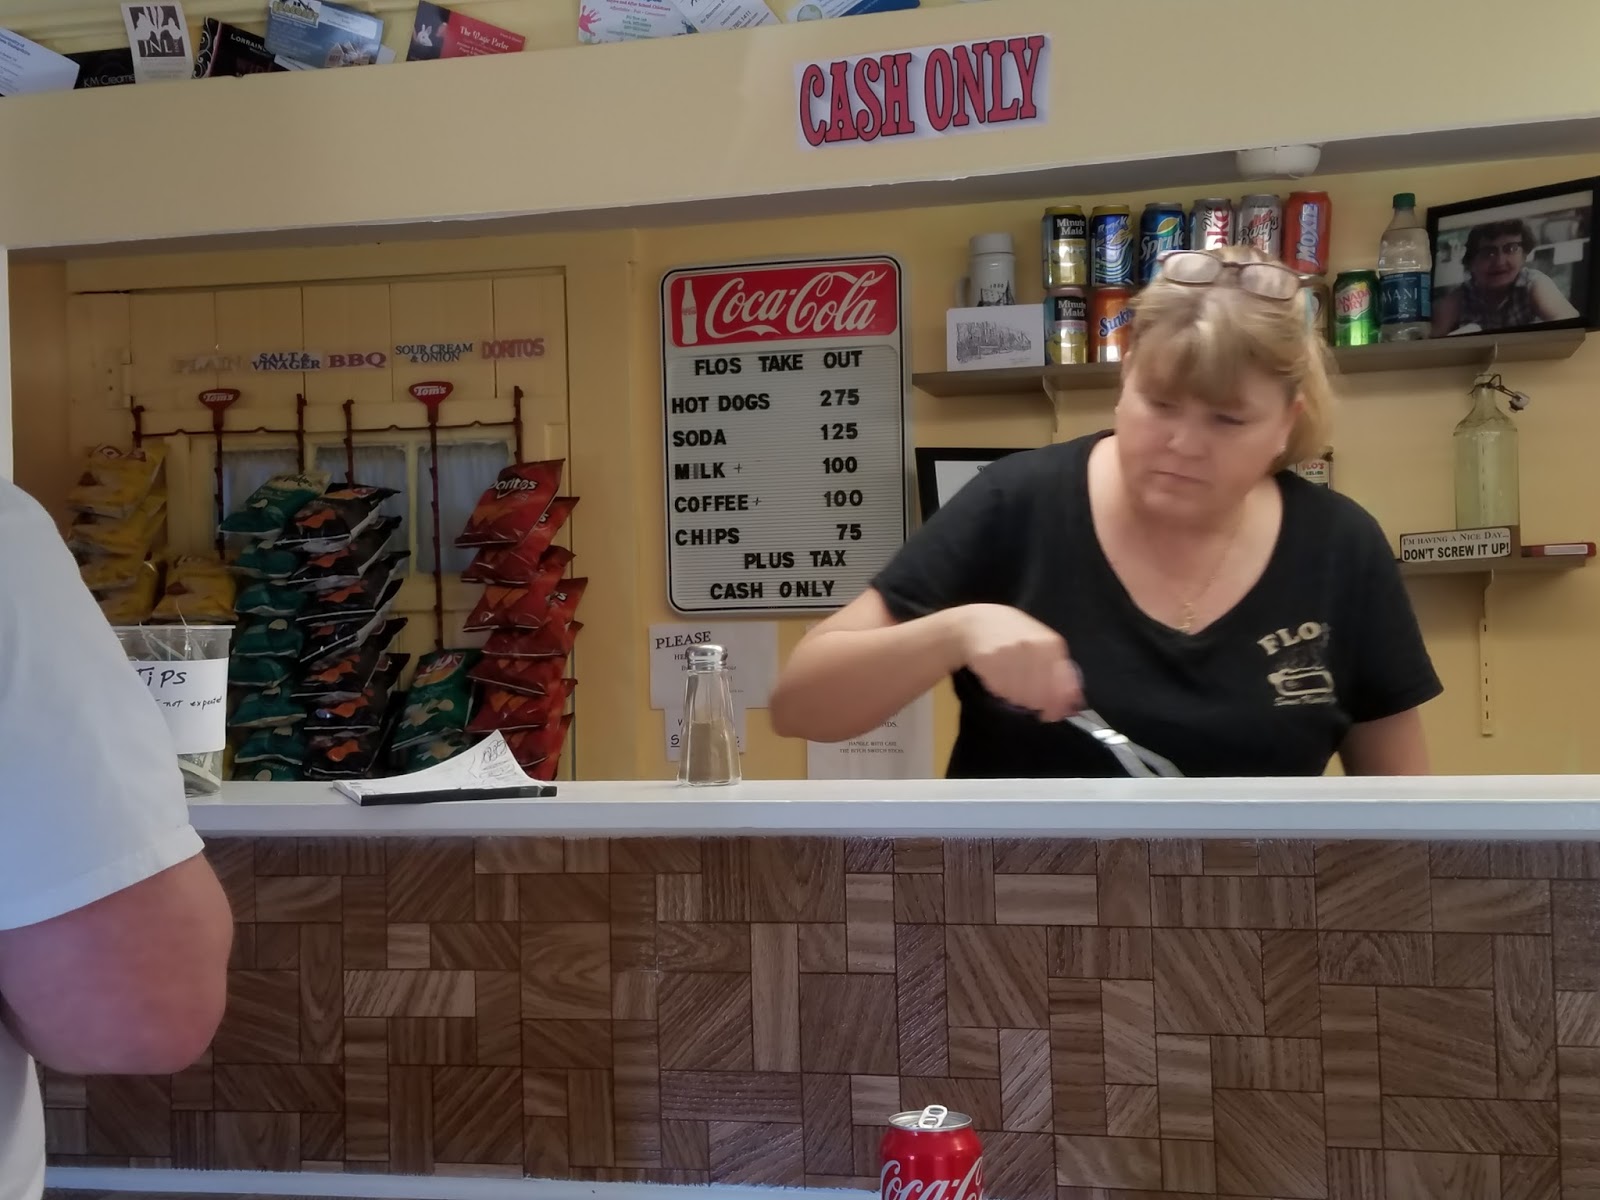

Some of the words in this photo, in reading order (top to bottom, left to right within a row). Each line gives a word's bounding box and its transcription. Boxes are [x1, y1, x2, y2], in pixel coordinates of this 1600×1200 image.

[460, 26, 471, 37] The
[144, 39, 172, 56] JNL
[800, 52, 915, 147] CASH
[924, 35, 1045, 132] ONLY
[1061, 227, 1084, 236] Maid
[1140, 230, 1185, 261] Sprite
[705, 269, 888, 339] Coca-Cola
[1062, 308, 1085, 317] Maid
[1342, 300, 1364, 313] DRY
[259, 352, 298, 363] SALT
[395, 344, 427, 355] SOUR
[430, 343, 474, 354] CREAM
[421, 352, 461, 363] ONION
[481, 338, 545, 359] DORITOS
[252, 359, 321, 371] VINAGER
[328, 353, 387, 369] BBQ
[694, 357, 742, 376] FLOS
[758, 354, 803, 373] TAKE
[823, 350, 862, 369] OUT
[203, 392, 234, 403] Tom's
[413, 385, 447, 397] Tom's
[672, 396, 709, 414] HOT
[718, 393, 770, 412] DOGS
[820, 388, 860, 407] 275
[673, 429, 727, 447] SODA
[820, 423, 858, 440] 125
[674, 462, 726, 480] MILK
[822, 456, 858, 474] 100
[674, 494, 749, 513] COFFEE
[824, 489, 863, 507] 100
[675, 527, 740, 546] CHIPS
[836, 523, 862, 541] 75
[1403, 538, 1415, 546] I'M
[1417, 535, 1448, 545] HAVING
[743, 551, 795, 570] PLUS
[809, 550, 847, 567] TAX
[1403, 548, 1435, 561] DON'T
[1437, 545, 1475, 558] SCREW
[1477, 544, 1488, 555] IT
[1491, 542, 1509, 555] UP!
[710, 582, 763, 600] CASH
[779, 580, 835, 598] ONLY
[655, 631, 712, 650] PLEASE
